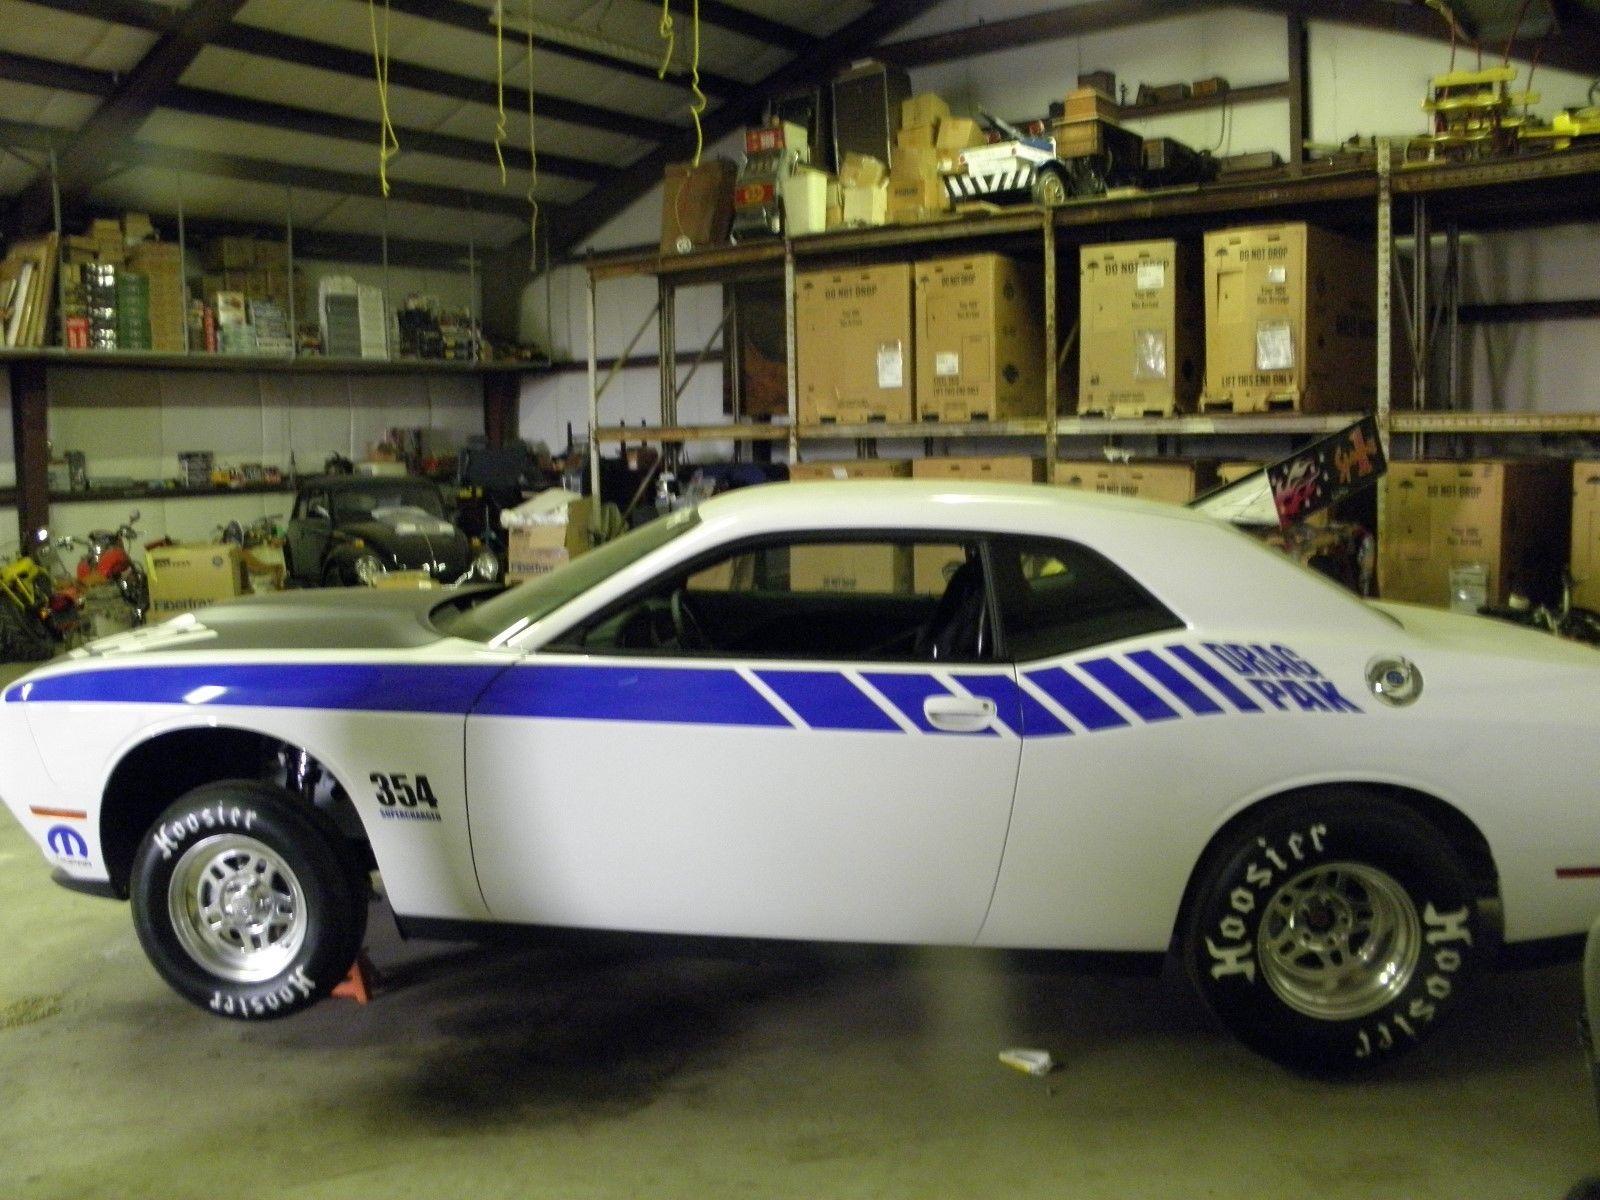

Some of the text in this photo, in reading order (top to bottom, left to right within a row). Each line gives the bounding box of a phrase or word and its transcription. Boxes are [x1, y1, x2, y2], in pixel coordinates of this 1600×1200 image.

[1200, 642, 1325, 679] DRAG
[1247, 678, 1366, 714] PAK
[369, 772, 438, 809] 354
